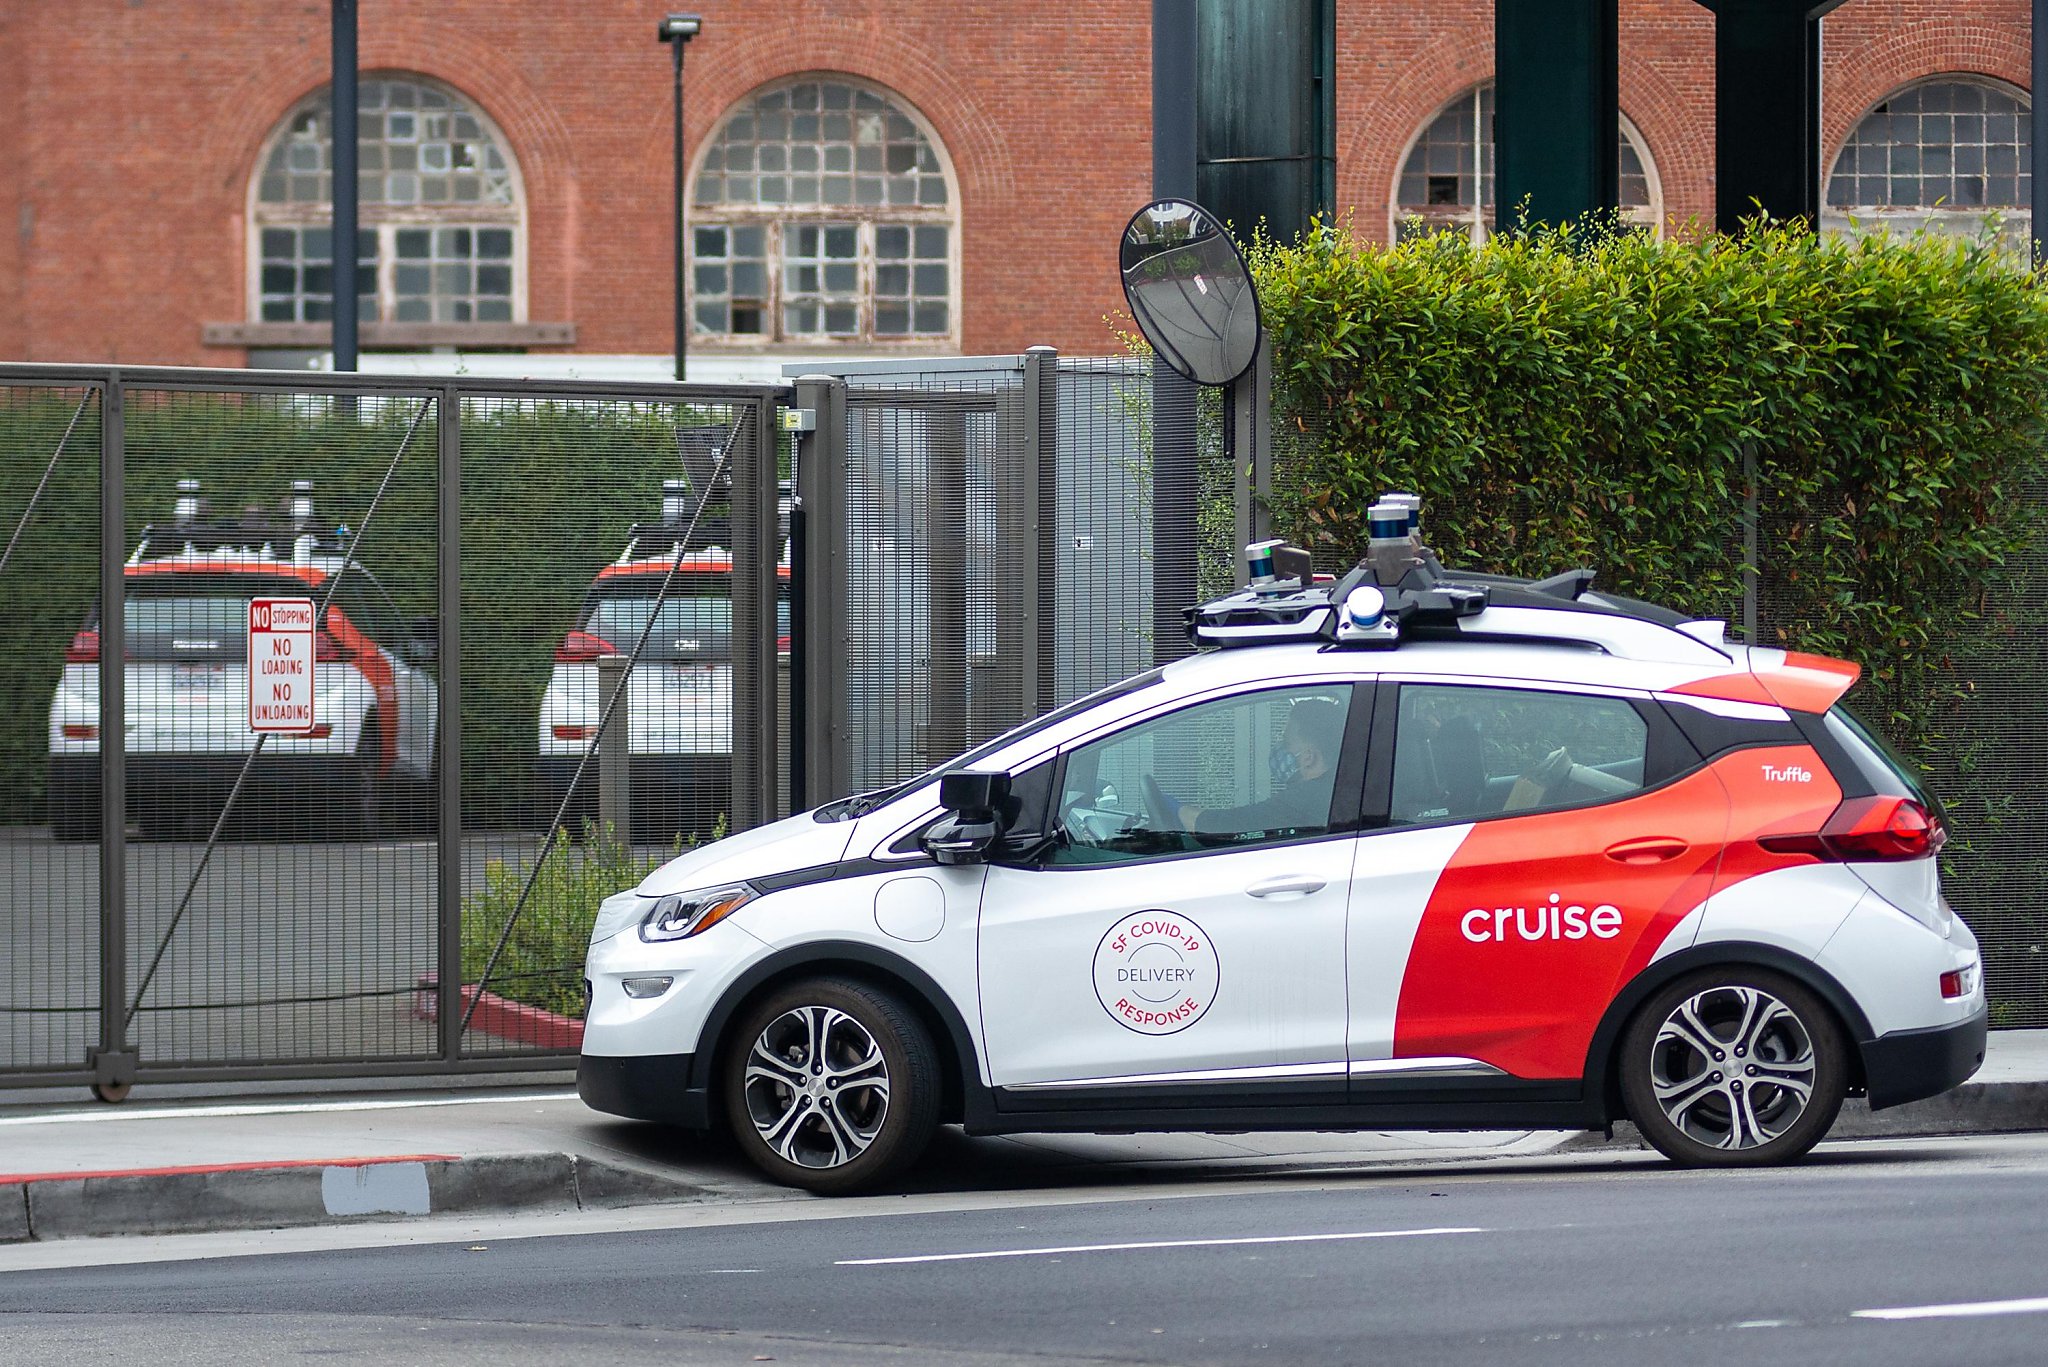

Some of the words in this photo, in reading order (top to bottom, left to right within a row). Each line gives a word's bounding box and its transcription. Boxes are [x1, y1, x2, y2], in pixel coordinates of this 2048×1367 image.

[252, 606, 270, 628] NO
[272, 610, 310, 624] STOPPING
[273, 638, 292, 656] NO
[262, 660, 303, 675] LOADING
[273, 683, 292, 701] NO
[255, 705, 309, 720] UNLOADING
[1761, 765, 1812, 783] Truffle
[1461, 893, 1623, 943] cruise
[1112, 933, 1128, 954] SF
[1130, 921, 1199, 951] COVID-19
[1117, 968, 1195, 982] DELIVERY
[1115, 997, 1199, 1026] RESPONSE
